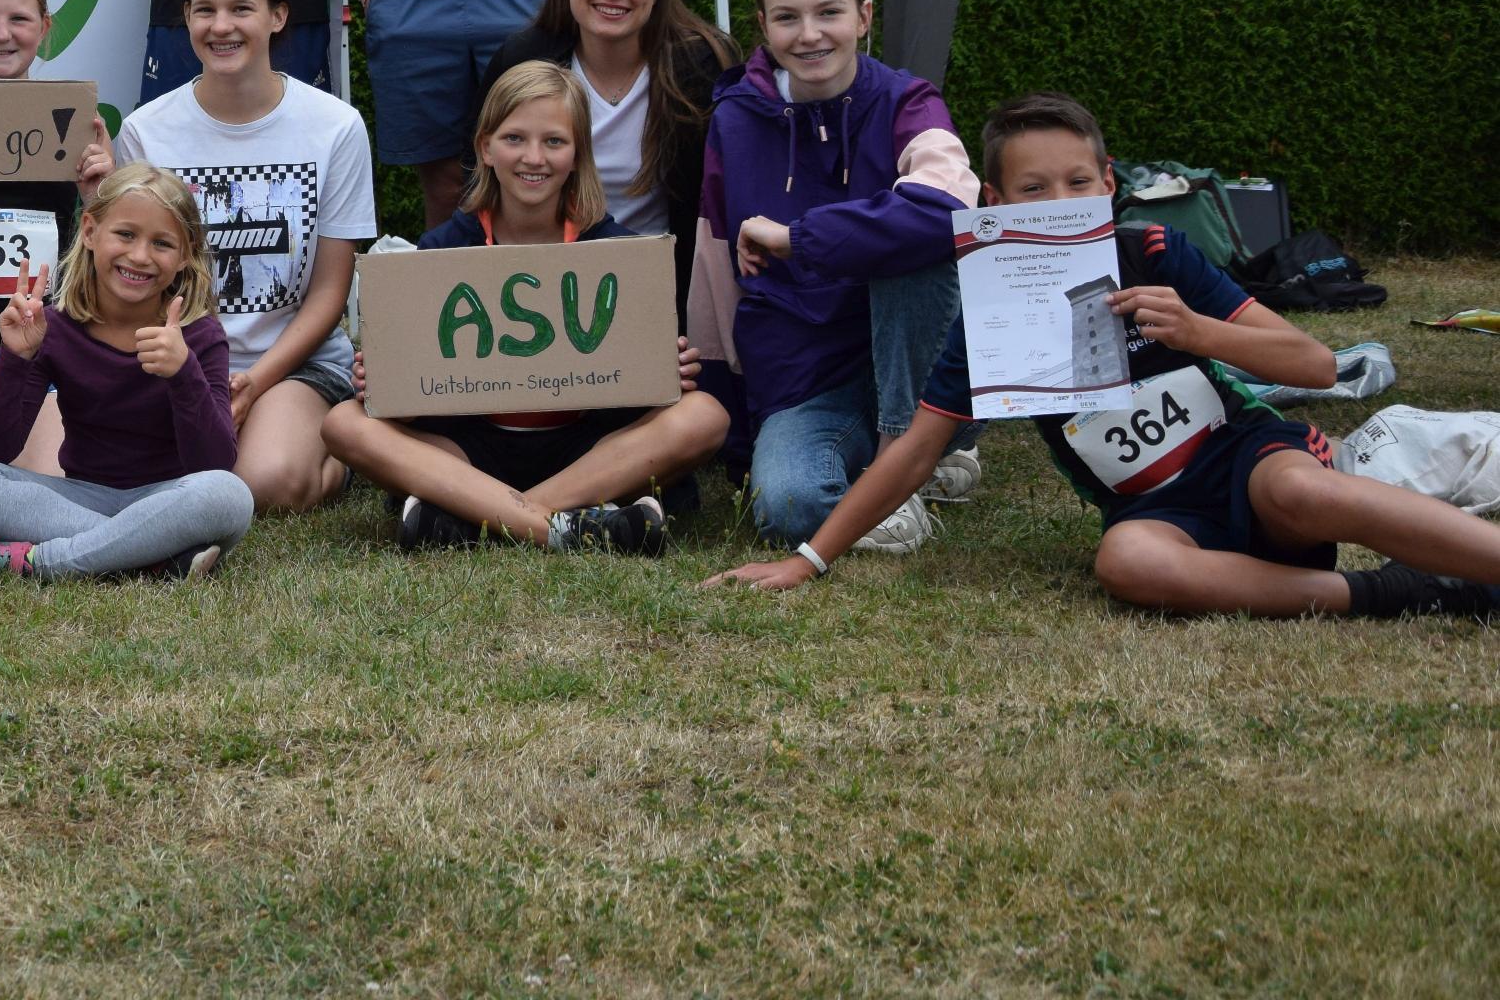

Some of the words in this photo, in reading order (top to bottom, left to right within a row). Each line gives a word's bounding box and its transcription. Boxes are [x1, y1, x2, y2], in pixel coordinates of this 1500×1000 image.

[1012, 217, 1026, 226] TSV
[1028, 215, 1046, 224] 1861
[1048, 212, 1078, 223] Zirndorf
[207, 227, 283, 249] PUMA
[994, 250, 1072, 263] Kreismeisterschaften
[437, 270, 618, 359] ASV
[1104, 390, 1192, 464] 364
